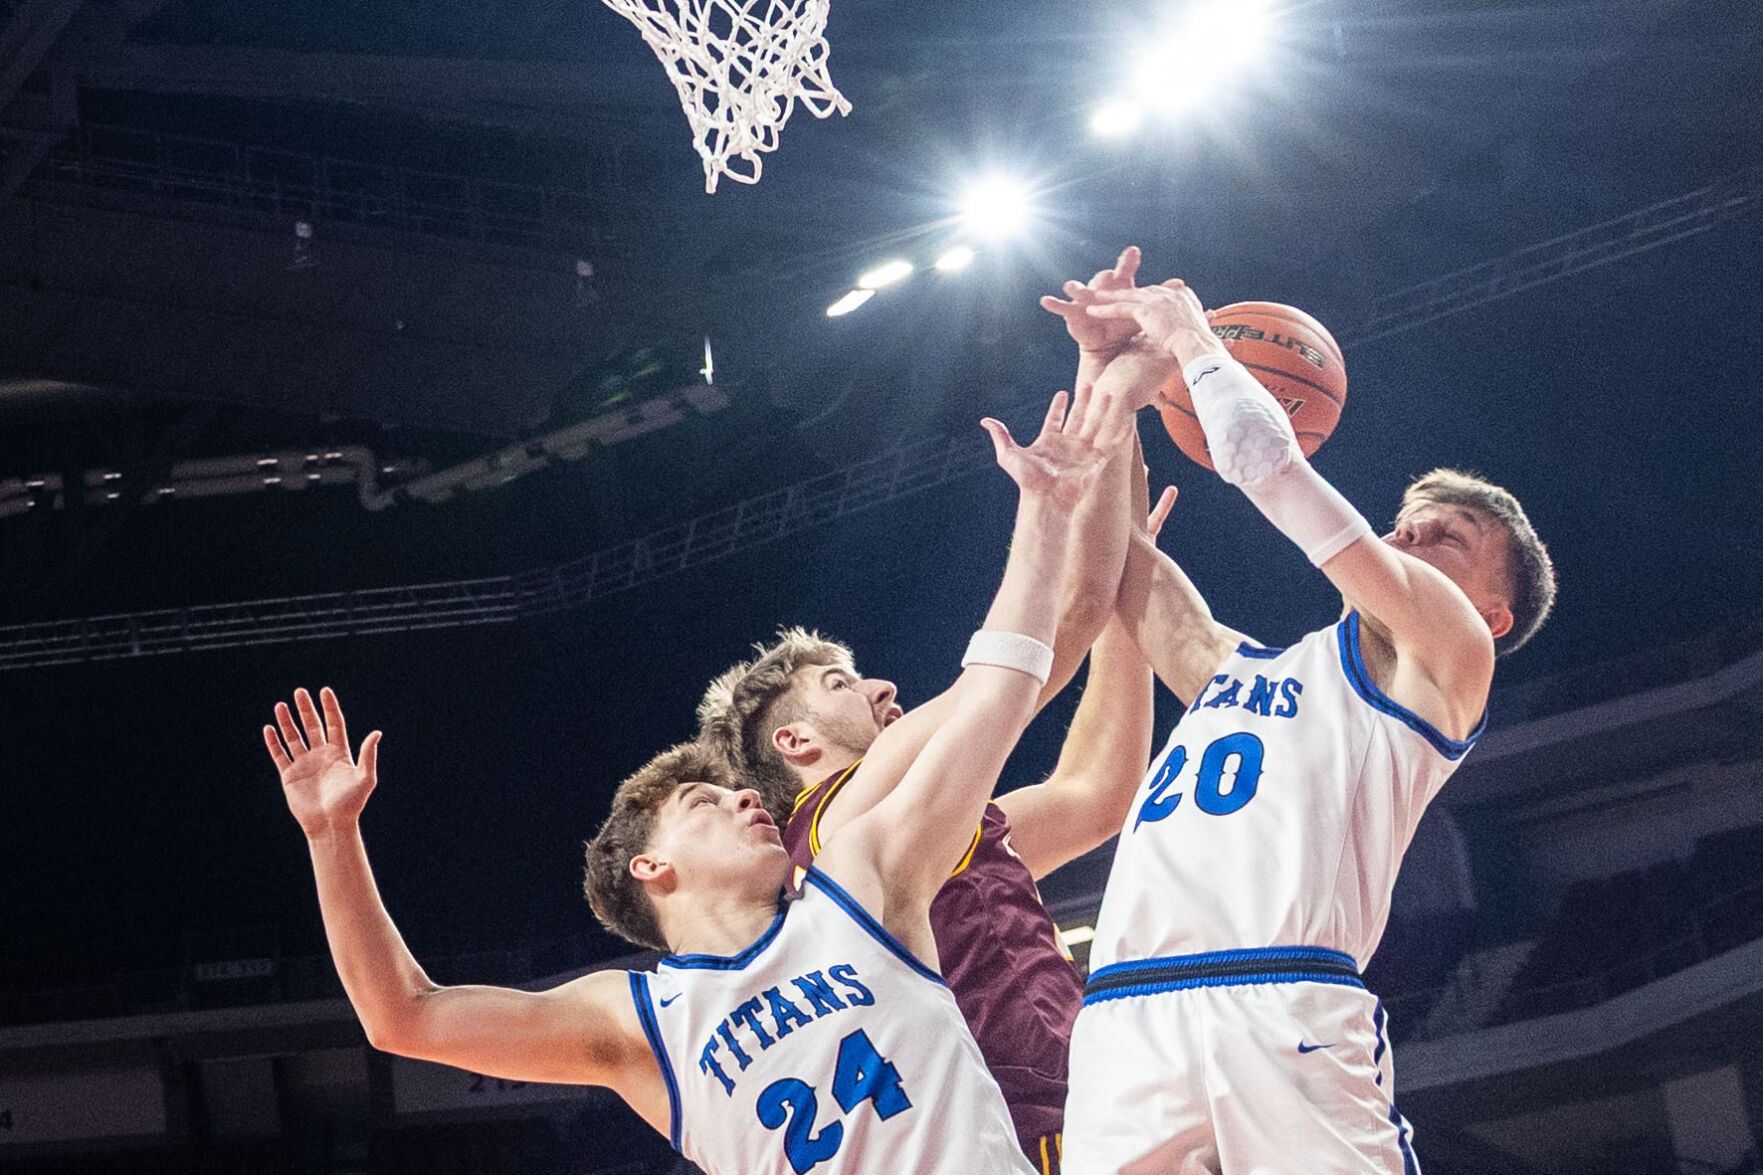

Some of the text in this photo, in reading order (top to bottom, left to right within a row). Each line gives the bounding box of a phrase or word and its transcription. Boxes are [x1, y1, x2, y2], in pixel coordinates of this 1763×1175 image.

[1211, 325, 1243, 340] PR
[1133, 731, 1265, 834] 20
[699, 963, 875, 1097] TITANS
[756, 1028, 913, 1175] 24
